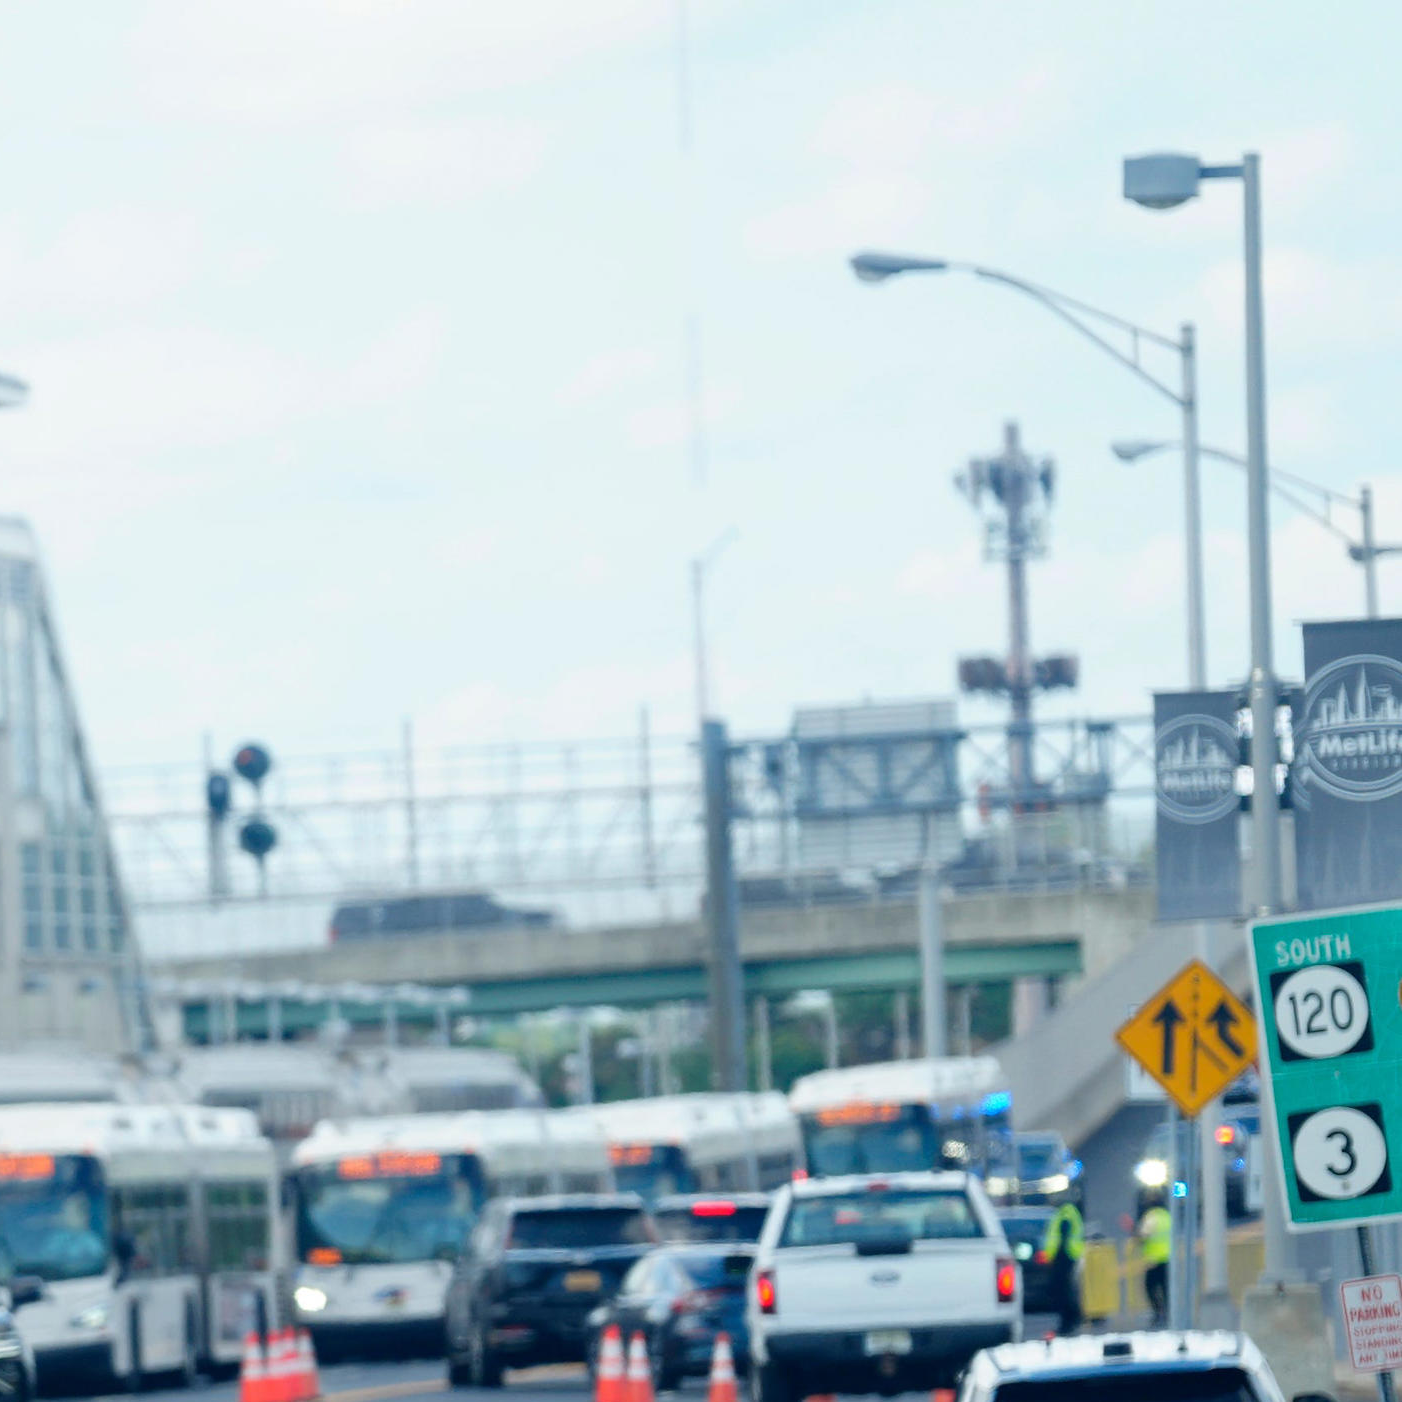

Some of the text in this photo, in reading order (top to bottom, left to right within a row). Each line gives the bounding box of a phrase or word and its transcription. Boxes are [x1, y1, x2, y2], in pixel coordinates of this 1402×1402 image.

[1275, 934, 1352, 967] SOUTH
[1289, 988, 1354, 1036] 120
[1325, 1129, 1356, 1176] 3
[1361, 1284, 1383, 1302] NO
